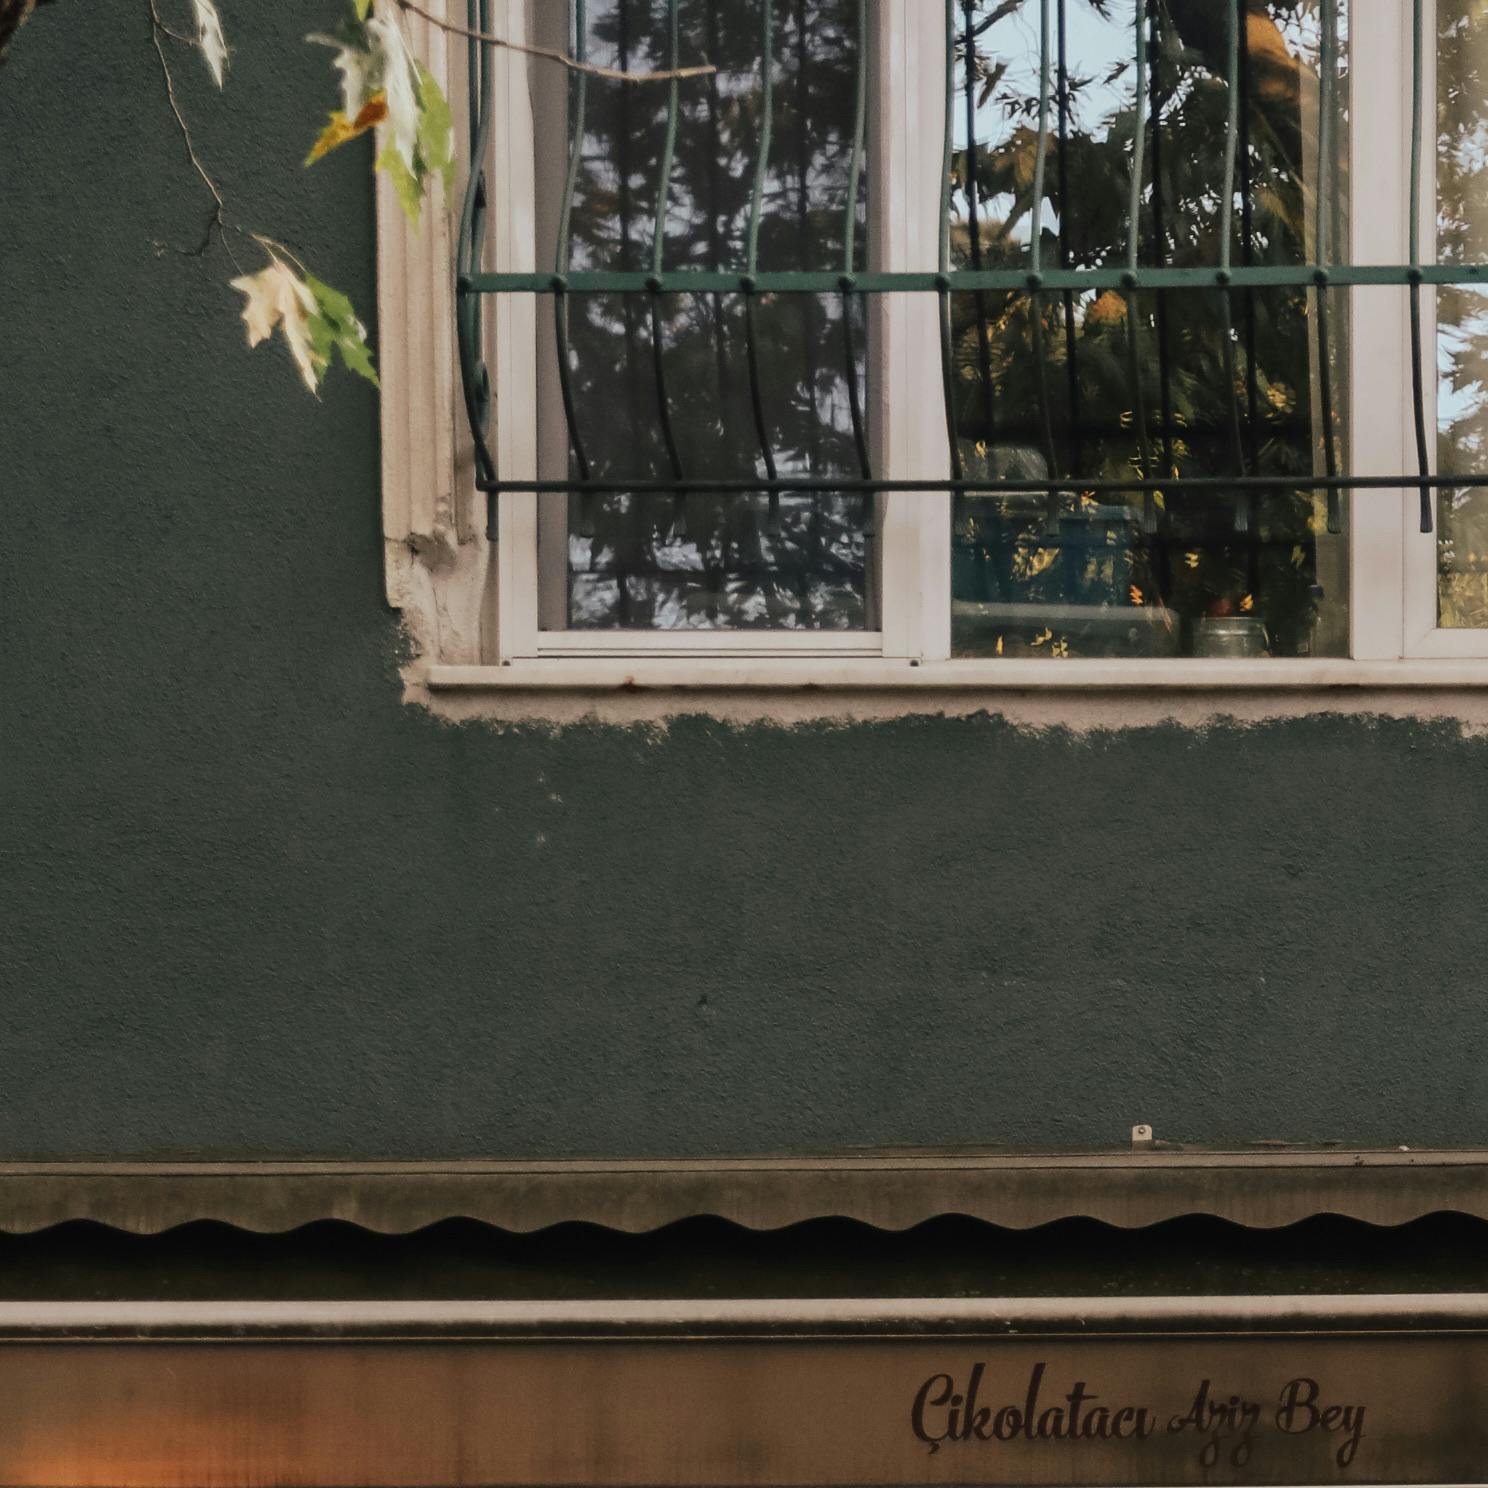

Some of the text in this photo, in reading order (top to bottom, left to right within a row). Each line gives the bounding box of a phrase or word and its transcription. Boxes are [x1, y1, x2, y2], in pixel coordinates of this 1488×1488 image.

[910, 1362, 1367, 1468] Çikolatacı Aziz Bey
